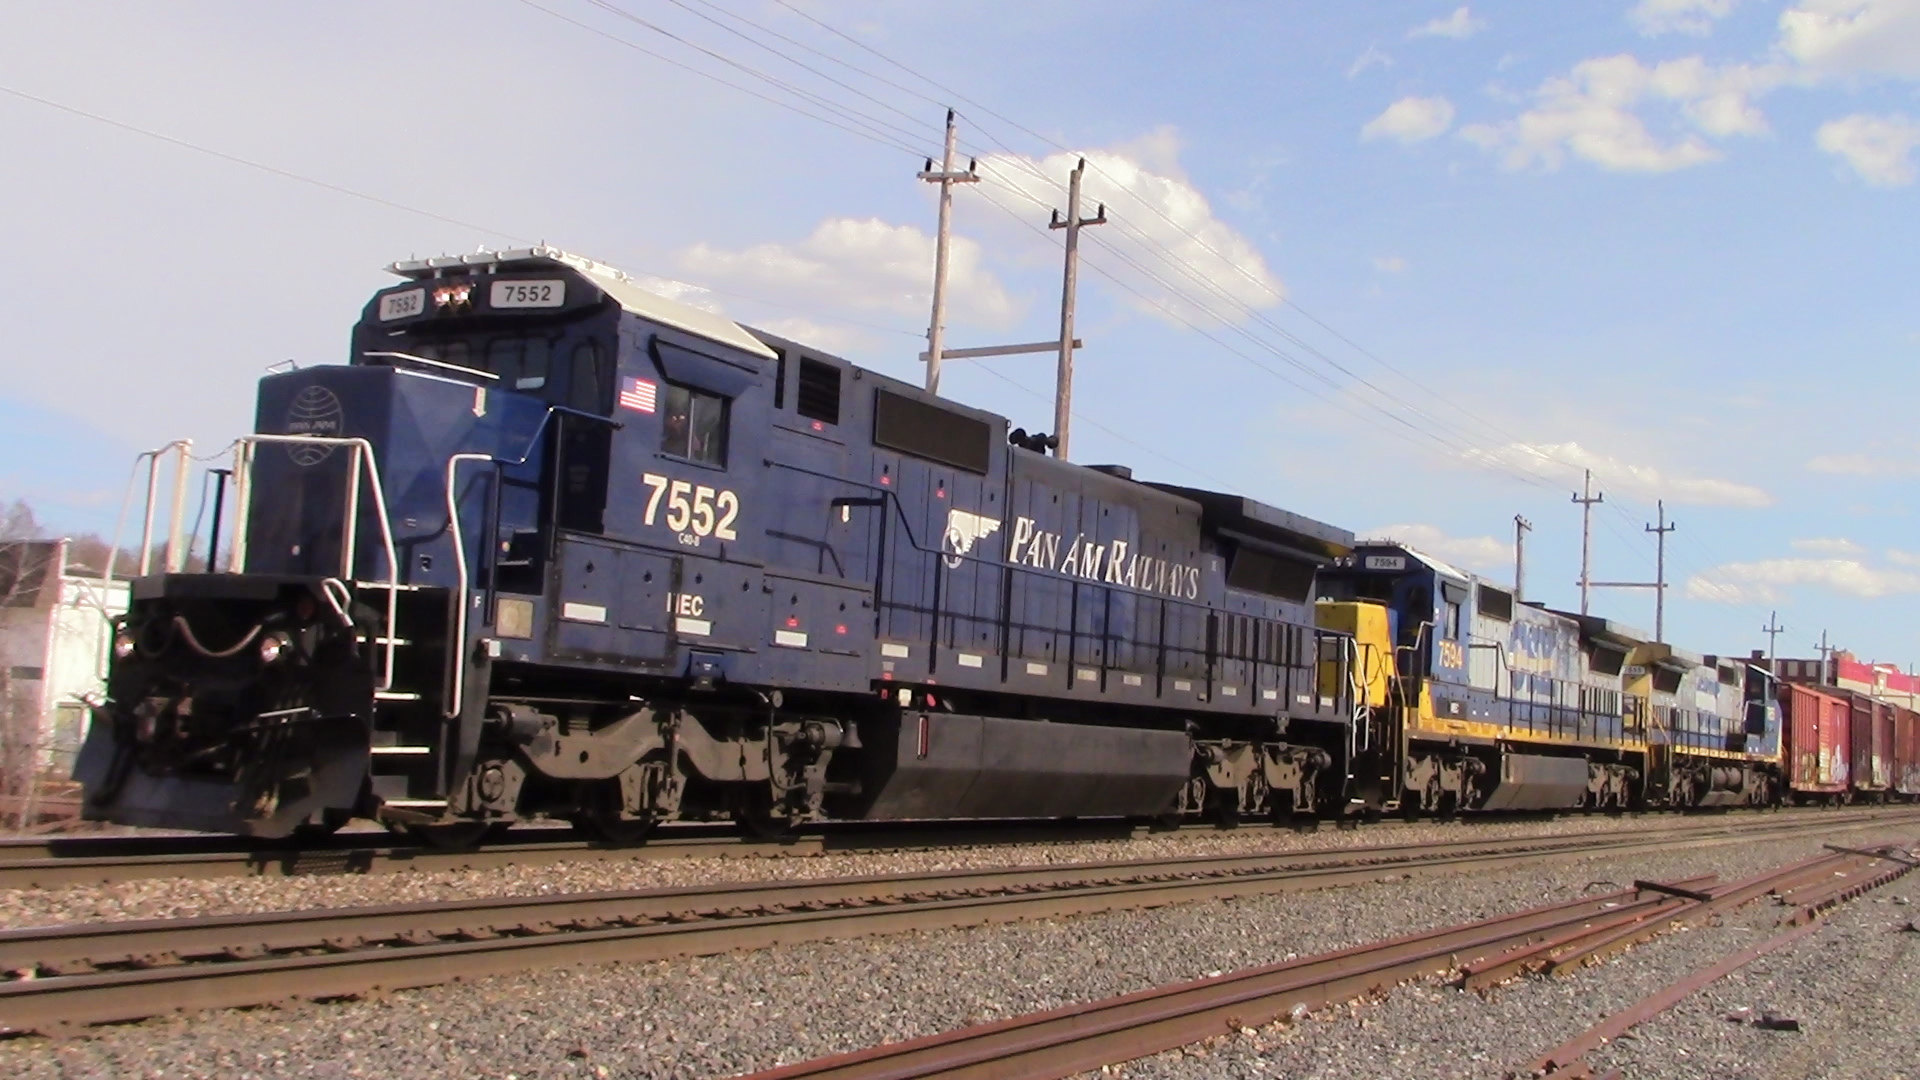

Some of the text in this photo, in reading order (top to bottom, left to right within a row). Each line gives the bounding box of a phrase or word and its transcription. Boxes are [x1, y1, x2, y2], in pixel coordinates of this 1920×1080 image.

[388, 295, 417, 314] 7552
[504, 285, 552, 302] 7552
[642, 472, 740, 541] 7552
[1008, 515, 1200, 600] PAN AM RAILWAYS
[1373, 557, 1398, 568] 7594
[1438, 640, 1463, 670] 7594
